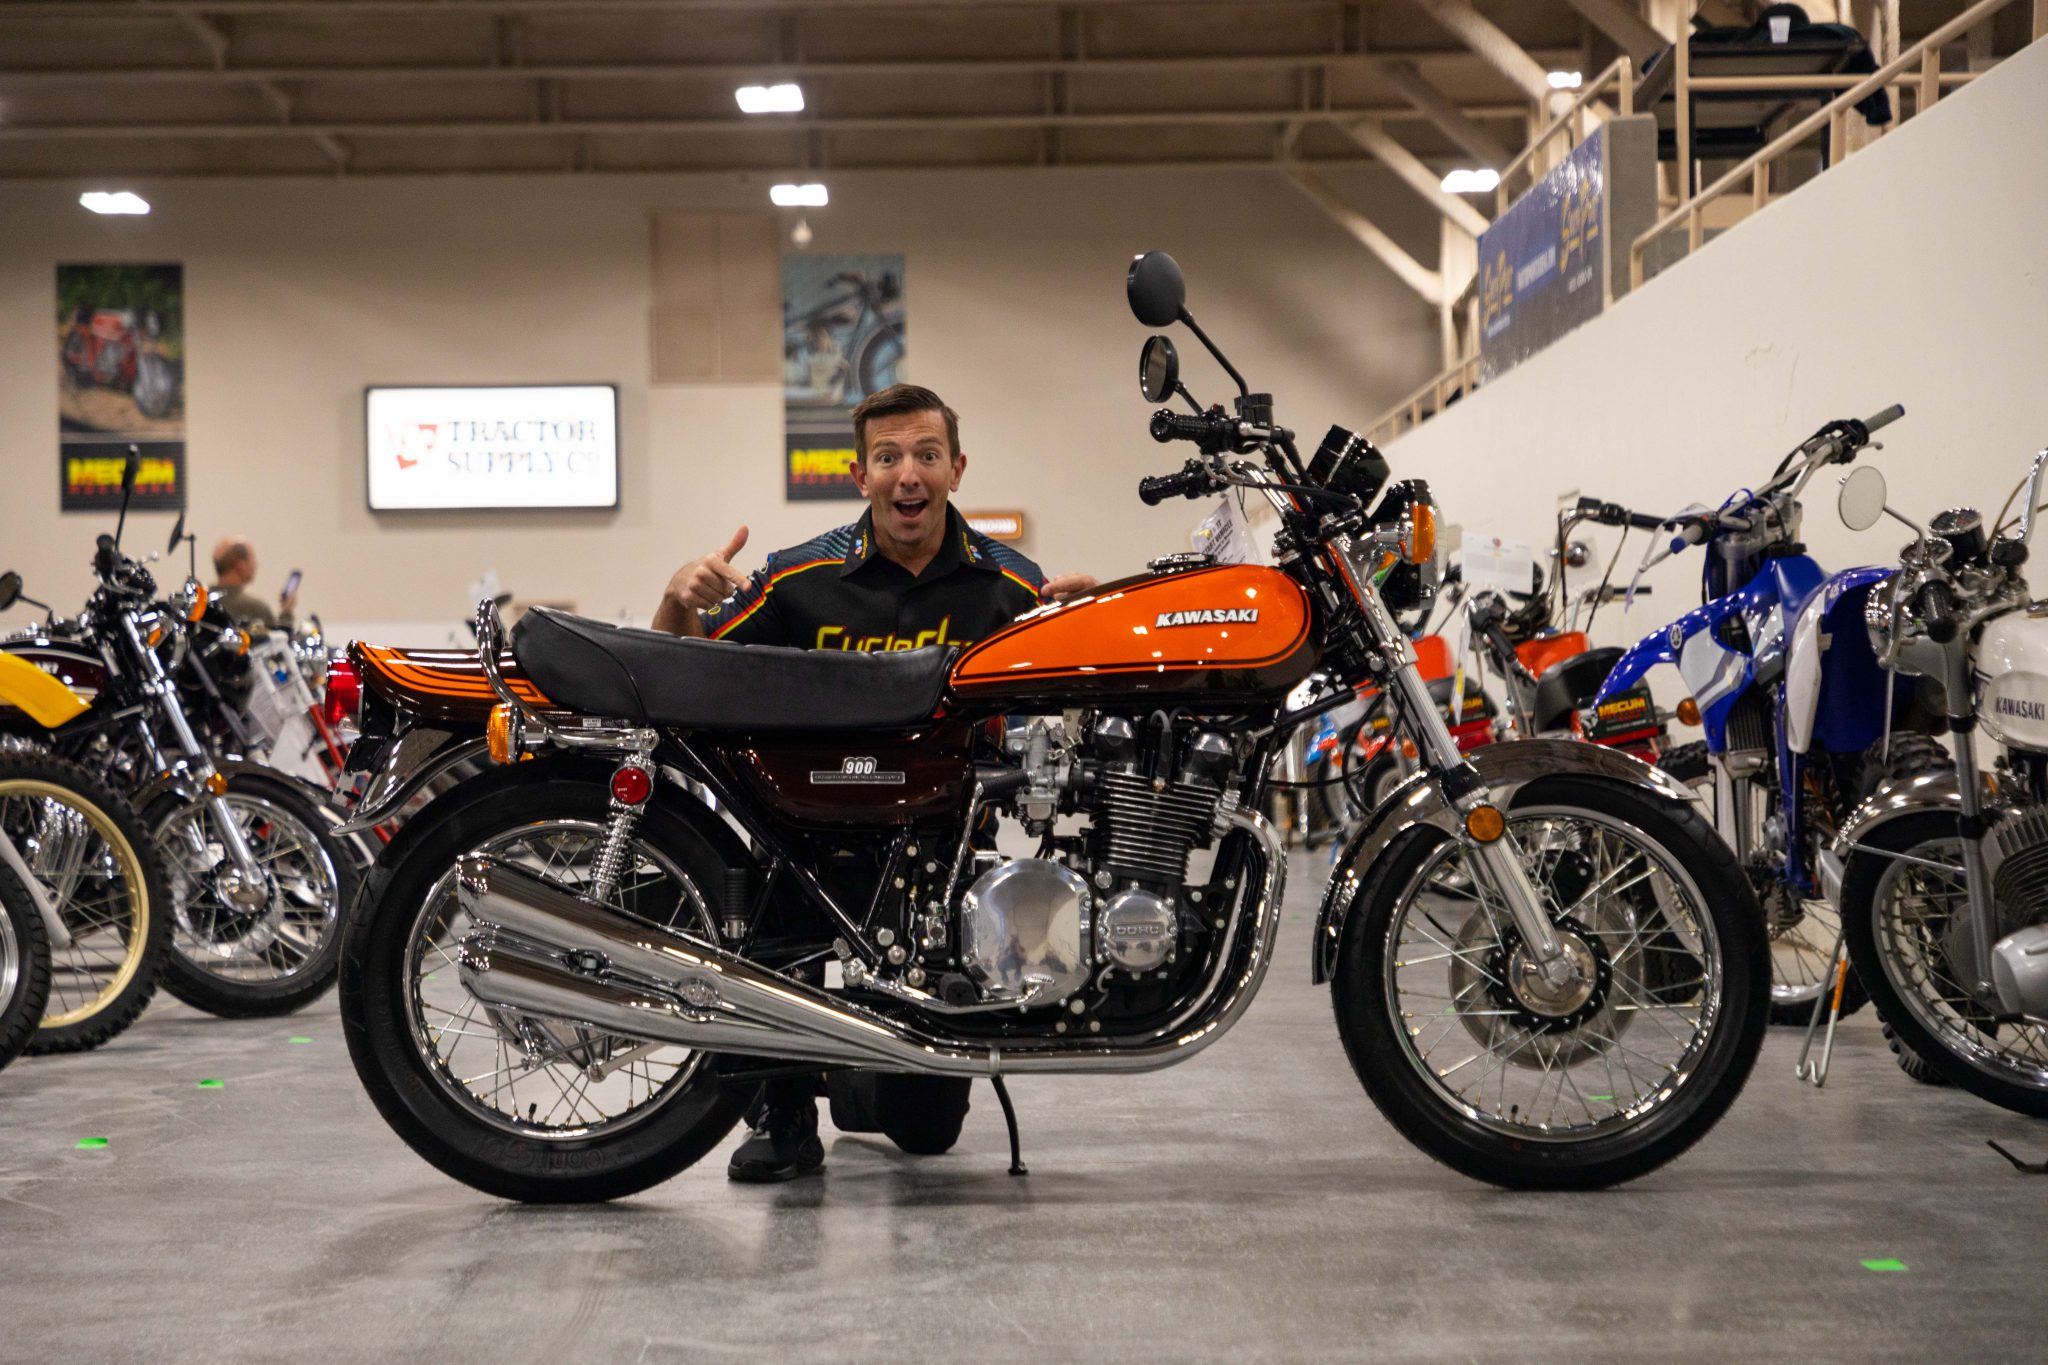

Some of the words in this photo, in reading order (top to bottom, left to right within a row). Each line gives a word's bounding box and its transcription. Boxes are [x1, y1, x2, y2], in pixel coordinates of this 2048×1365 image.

[448, 421, 596, 441] TRACTOR
[448, 452, 554, 473] SUPPLY
[1155, 608, 1259, 628] KAWASAKI
[1598, 697, 1646, 717] MECUM
[1996, 696, 2045, 720] KAWASAKI
[845, 761, 874, 775] 900
[1116, 926, 1159, 935] DOHC
